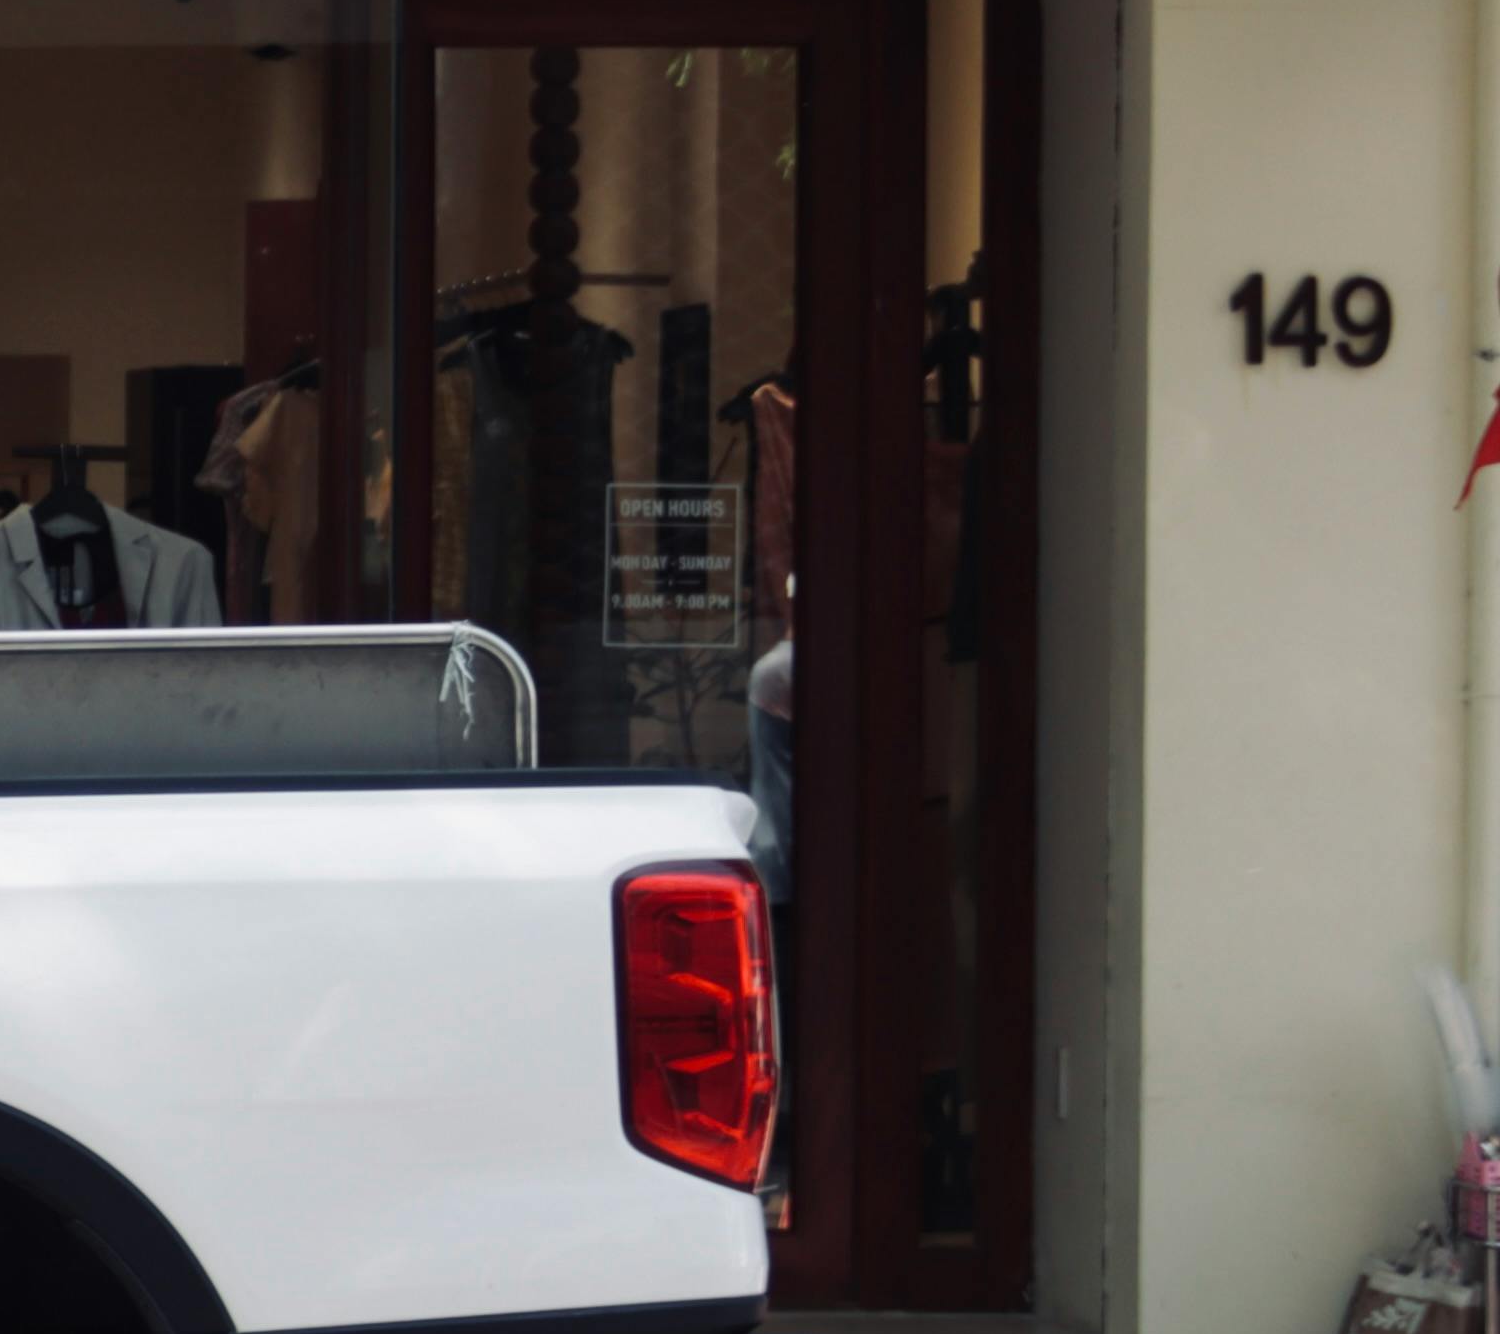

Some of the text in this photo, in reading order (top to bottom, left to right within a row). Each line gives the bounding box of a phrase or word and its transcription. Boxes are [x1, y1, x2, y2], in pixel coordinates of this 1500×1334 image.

[1228, 272, 1393, 368] 149
[621, 499, 724, 517] OPEN HOURS
[611, 556, 667, 570] MONDAY
[680, 555, 731, 570] SUNDAY
[708, 595, 730, 610] PM
